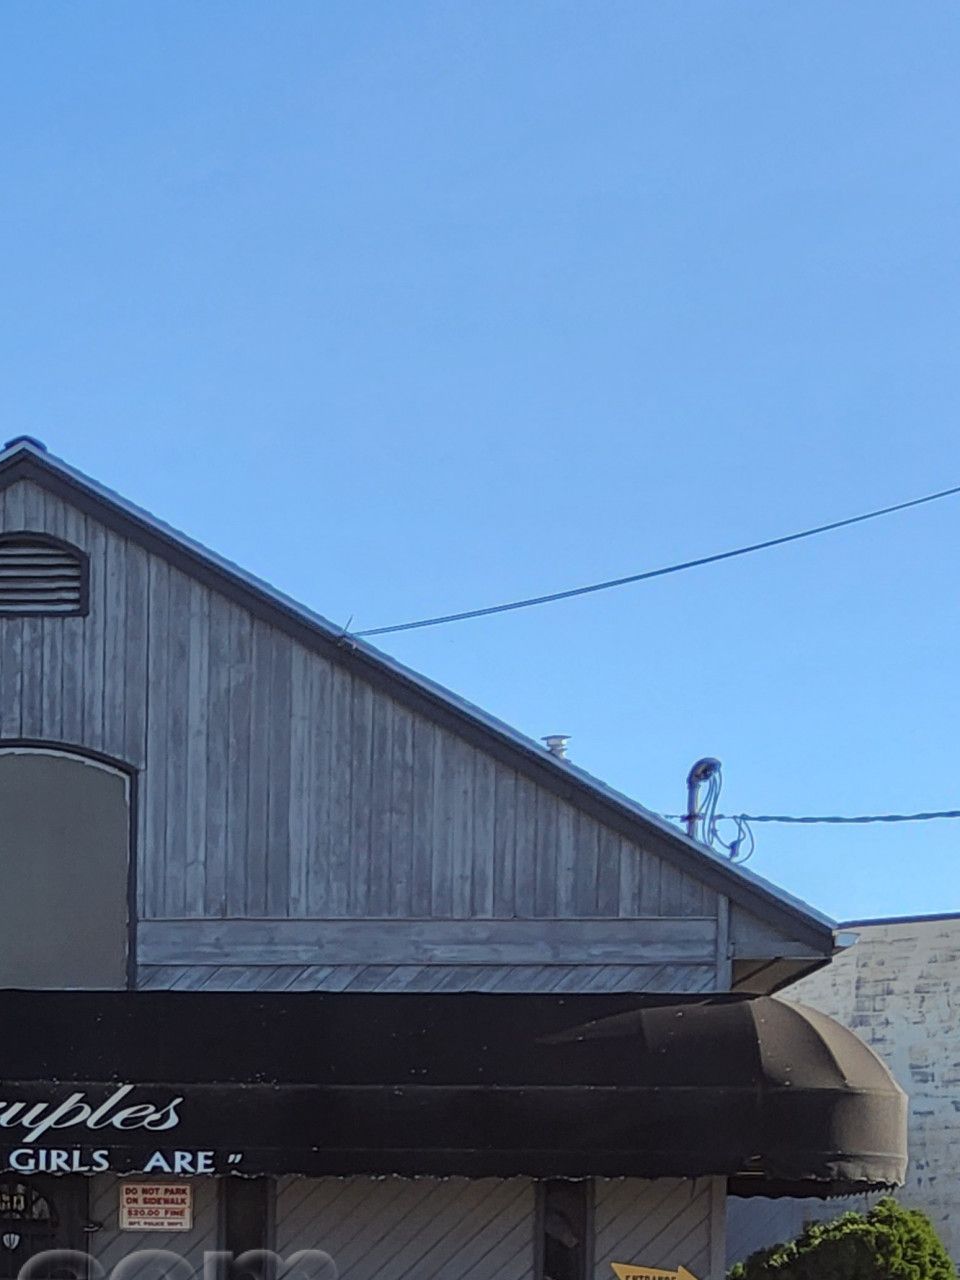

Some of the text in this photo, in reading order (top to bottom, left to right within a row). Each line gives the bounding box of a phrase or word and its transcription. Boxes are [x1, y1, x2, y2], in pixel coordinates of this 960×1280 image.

[8, 1148, 110, 1172] GIRLS
[125, 1187, 188, 1195] DO NOT PARK
[143, 1197, 187, 1205] SIDEWALK
